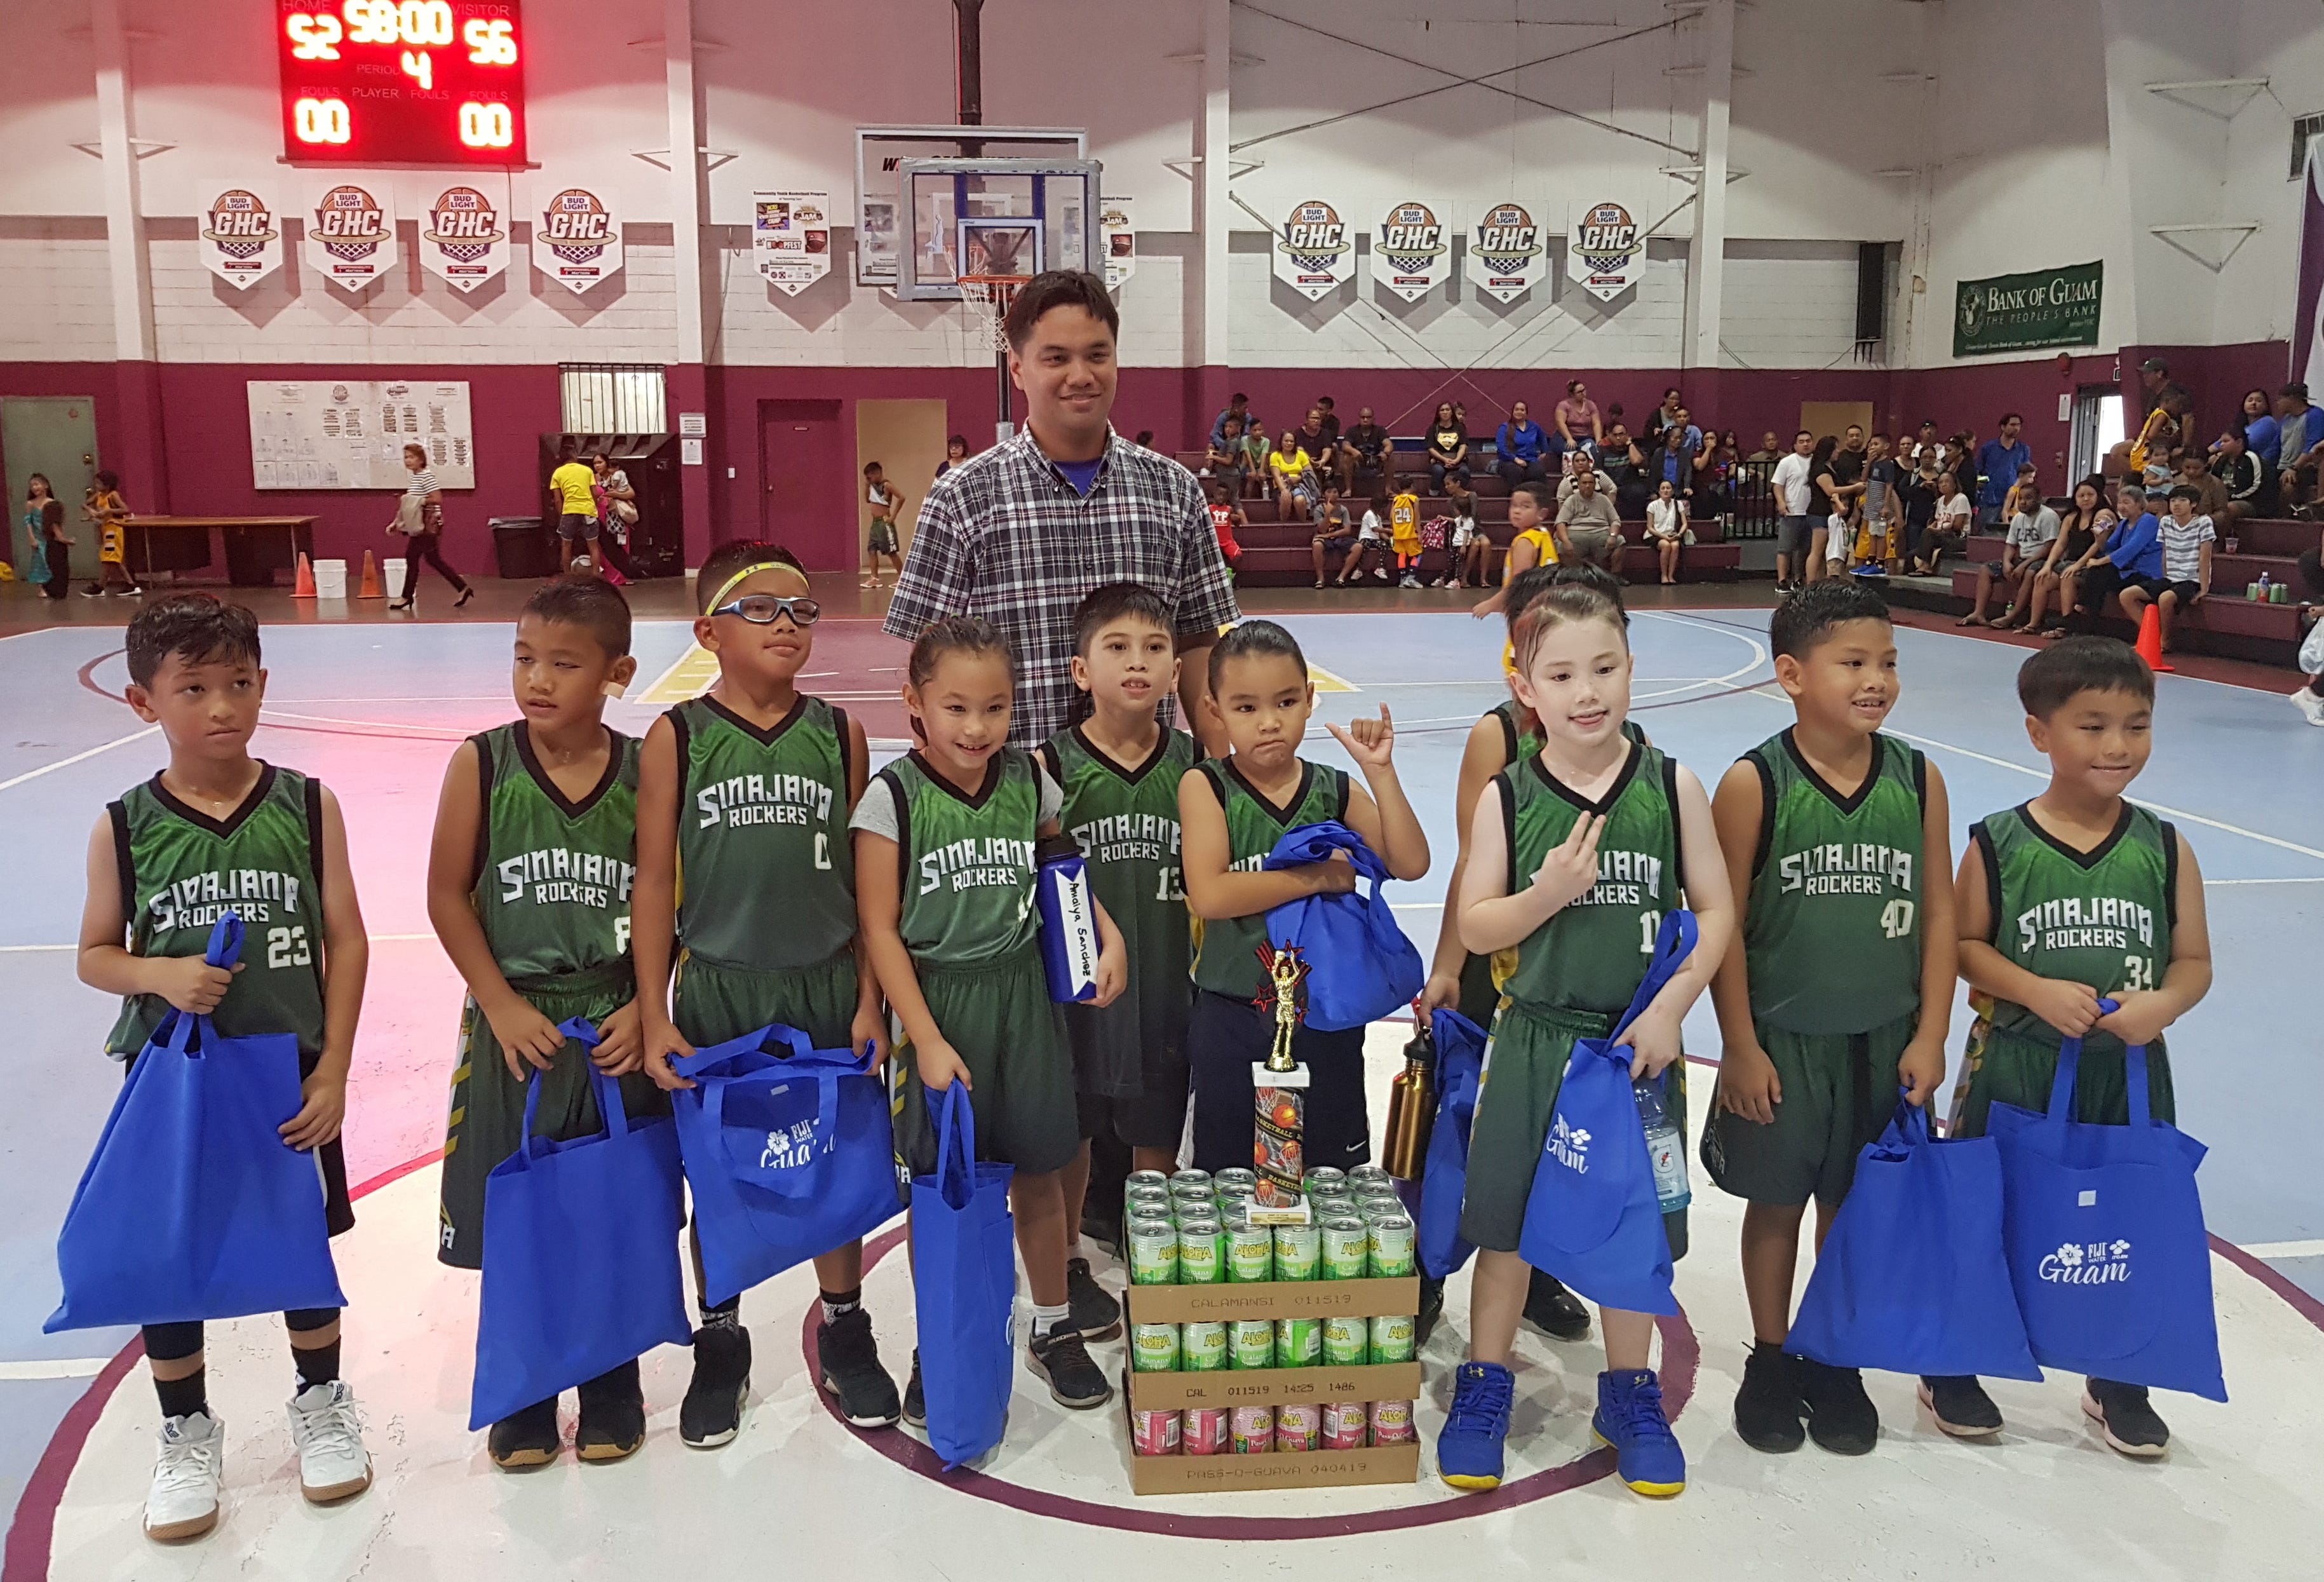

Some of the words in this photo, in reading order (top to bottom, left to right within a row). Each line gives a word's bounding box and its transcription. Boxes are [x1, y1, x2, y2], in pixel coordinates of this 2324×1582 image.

[452, 4, 510, 17] VISITOR
[287, 14, 342, 60] 52
[464, 18, 517, 64] 56
[356, 64, 401, 76] PERIOD
[400, 50, 432, 90] 4
[301, 86, 341, 98] FOULS
[352, 87, 399, 98] PLAYER
[410, 89, 450, 100] FOULS
[469, 90, 509, 102] FOULS
[294, 98, 351, 144] 00
[459, 102, 513, 147] 00
[215, 212, 268, 236] GHC
[323, 210, 380, 236] GHC
[436, 212, 494, 236] GHC
[550, 213, 607, 238] GHC
[1290, 224, 1342, 248] GHC
[1386, 226, 1439, 250] GHC
[1482, 226, 1534, 251] GHC
[1583, 226, 1634, 250] GHC
[1987, 287, 2027, 313] BANK
[2029, 288, 2046, 306] OF
[2050, 278, 2097, 305] GUAM
[1987, 316, 2004, 326] THE
[2065, 305, 2096, 318] BANK
[1395, 507, 1411, 524] 24
[696, 774, 833, 830] SINAJANA
[728, 805, 807, 828] ROCKERS
[1100, 841, 1160, 864] ROCKERS
[951, 868, 1018, 893] ROCKERS
[1780, 844, 1912, 895] SINAJANA
[1564, 884, 1640, 908] OCKERS
[1805, 875, 1882, 896] ROCKERS
[149, 869, 299, 934] SINAJANA
[1880, 898, 1914, 939] 40
[2017, 897, 2153, 953] SINAJANA
[267, 925, 311, 969] 23
[2045, 928, 2126, 951] ROCKERS
[1078, 927, 1091, 977] Sanchez
[794, 1132, 813, 1144] WATER
[1256, 1116, 1293, 1139] ASKETBALL
[1234, 1241, 1270, 1258] ALOHA
[2039, 1254, 2131, 1285] Guam
[1191, 1297, 1275, 1309] CALAMANSI
[1295, 1294, 1351, 1306] 011519
[1136, 1332, 1171, 1349] ALOHA
[1186, 1388, 1207, 1398] CAL
[1227, 1385, 1270, 1396] 011519
[1329, 1382, 1355, 1392] 1486
[1187, 1465, 1301, 1479] PASS-O-GUAVA
[1311, 1462, 1367, 1474] 040419
